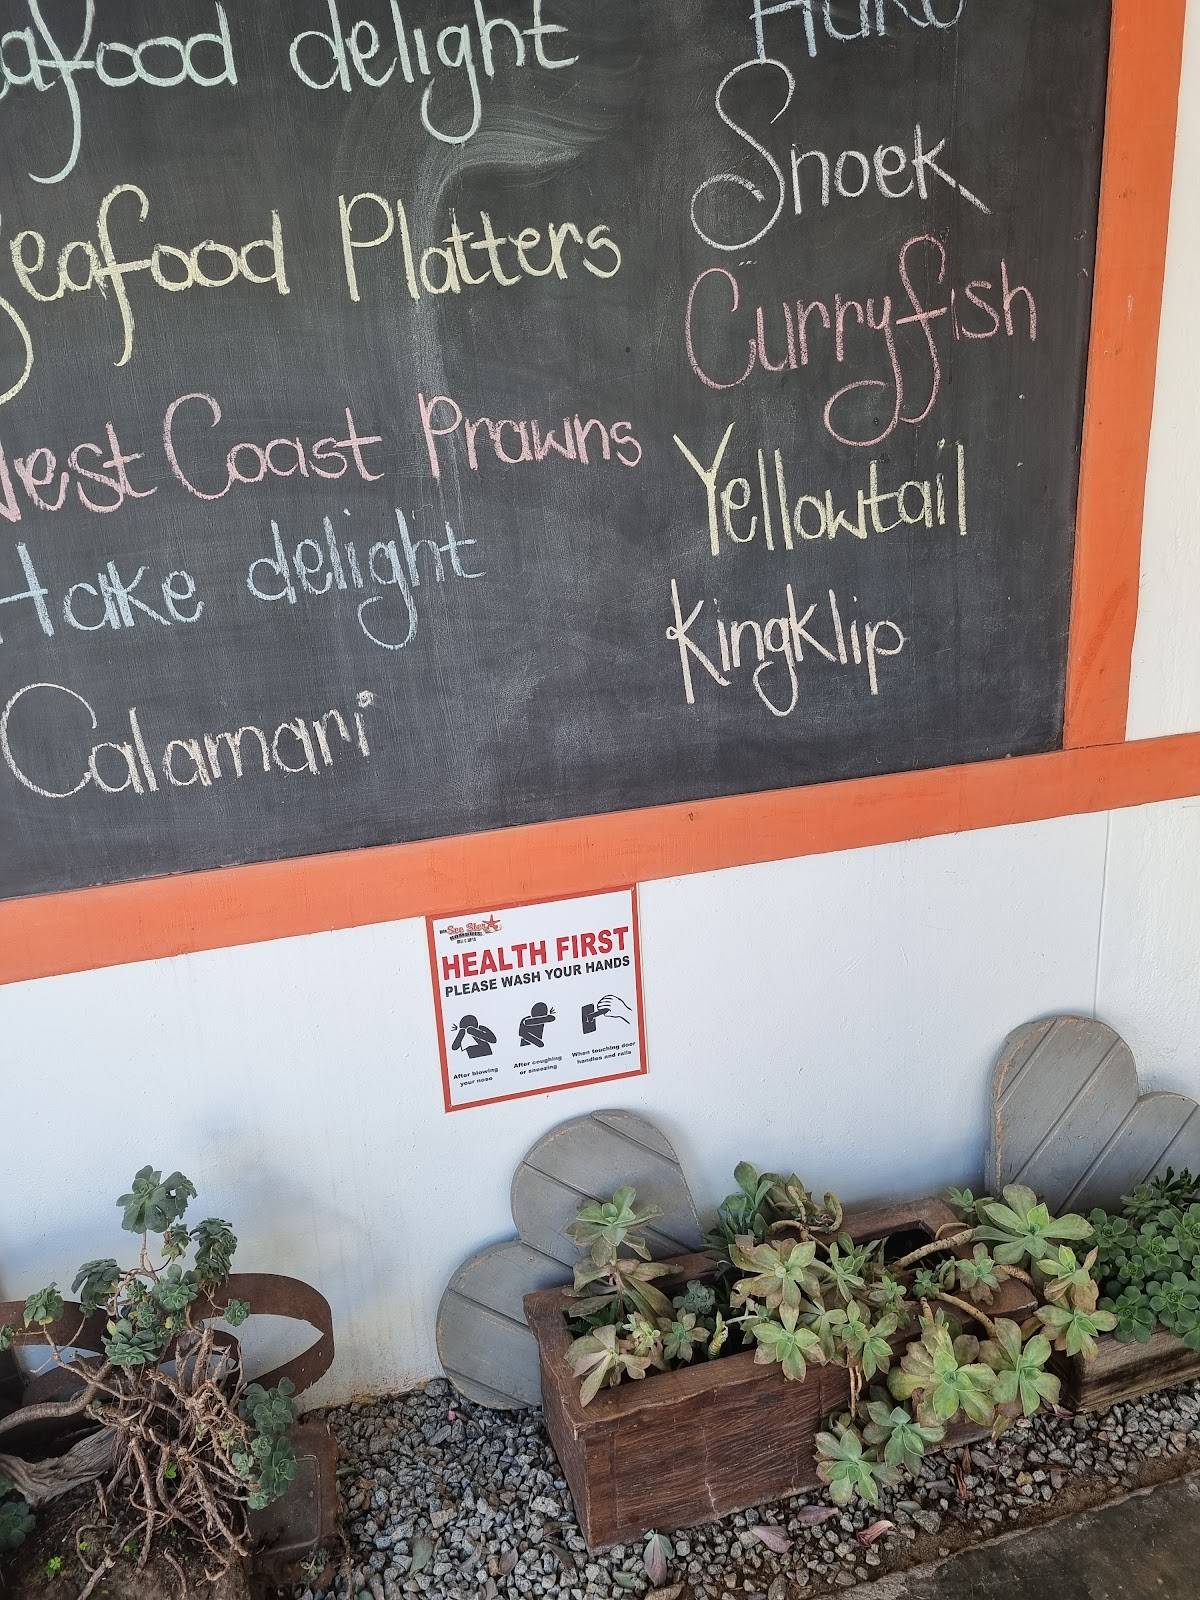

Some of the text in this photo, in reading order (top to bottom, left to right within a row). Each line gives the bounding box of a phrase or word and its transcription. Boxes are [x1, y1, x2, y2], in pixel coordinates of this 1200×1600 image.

[0, 0, 580, 184] afood delight
[691, 58, 993, 250] Snoek
[339, 192, 622, 302] Platters
[685, 234, 1036, 446] Curryfish
[163, 393, 385, 499] Coast
[418, 392, 643, 479] Prawns
[672, 421, 967, 556] Yellowtail
[247, 508, 487, 650] delight
[0, 682, 375, 798] Calamari
[441, 926, 630, 981] HEALTH FIRST
[445, 955, 630, 998] PLEASE WASH YOUR HANDS
[453, 1067, 499, 1080] After blowing
[459, 1075, 493, 1088] your nose
[513, 1055, 562, 1069] After coughing
[528, 1064, 558, 1074] sneezing
[571, 1050, 590, 1058] When
[592, 1044, 620, 1054] touching
[577, 1055, 603, 1065] handles
